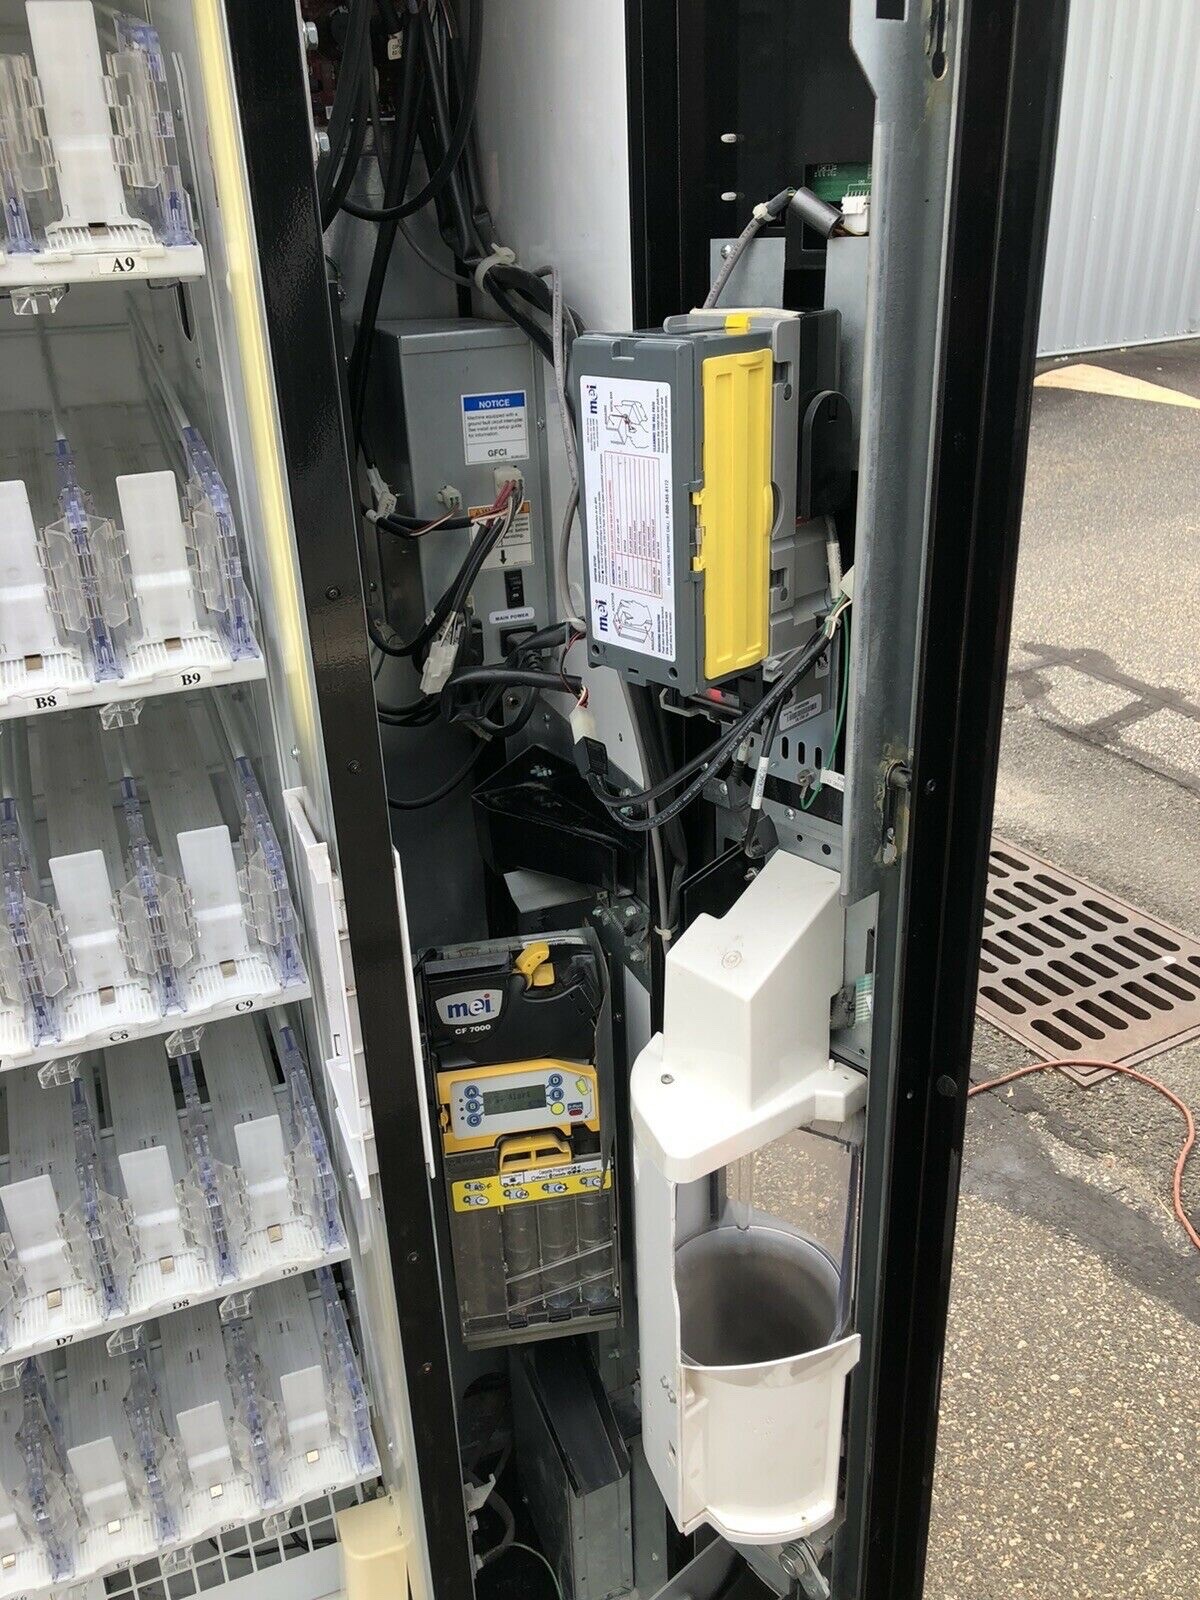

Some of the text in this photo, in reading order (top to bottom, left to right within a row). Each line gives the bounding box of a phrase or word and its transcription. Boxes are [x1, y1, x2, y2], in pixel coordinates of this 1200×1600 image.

[112, 256, 135, 272] A9
[478, 398, 510, 408] NOTICE
[586, 384, 598, 414] mei
[488, 448, 507, 457] GFCI
[595, 598, 608, 632] mei
[182, 672, 201, 686] B9
[35, 695, 57, 709] B8
[236, 1000, 253, 1012] C9
[448, 993, 491, 1018] mei
[470, 1024, 491, 1033] 7000
[172, 1299, 189, 1310] D8
[56, 1334, 74, 1346] D7
